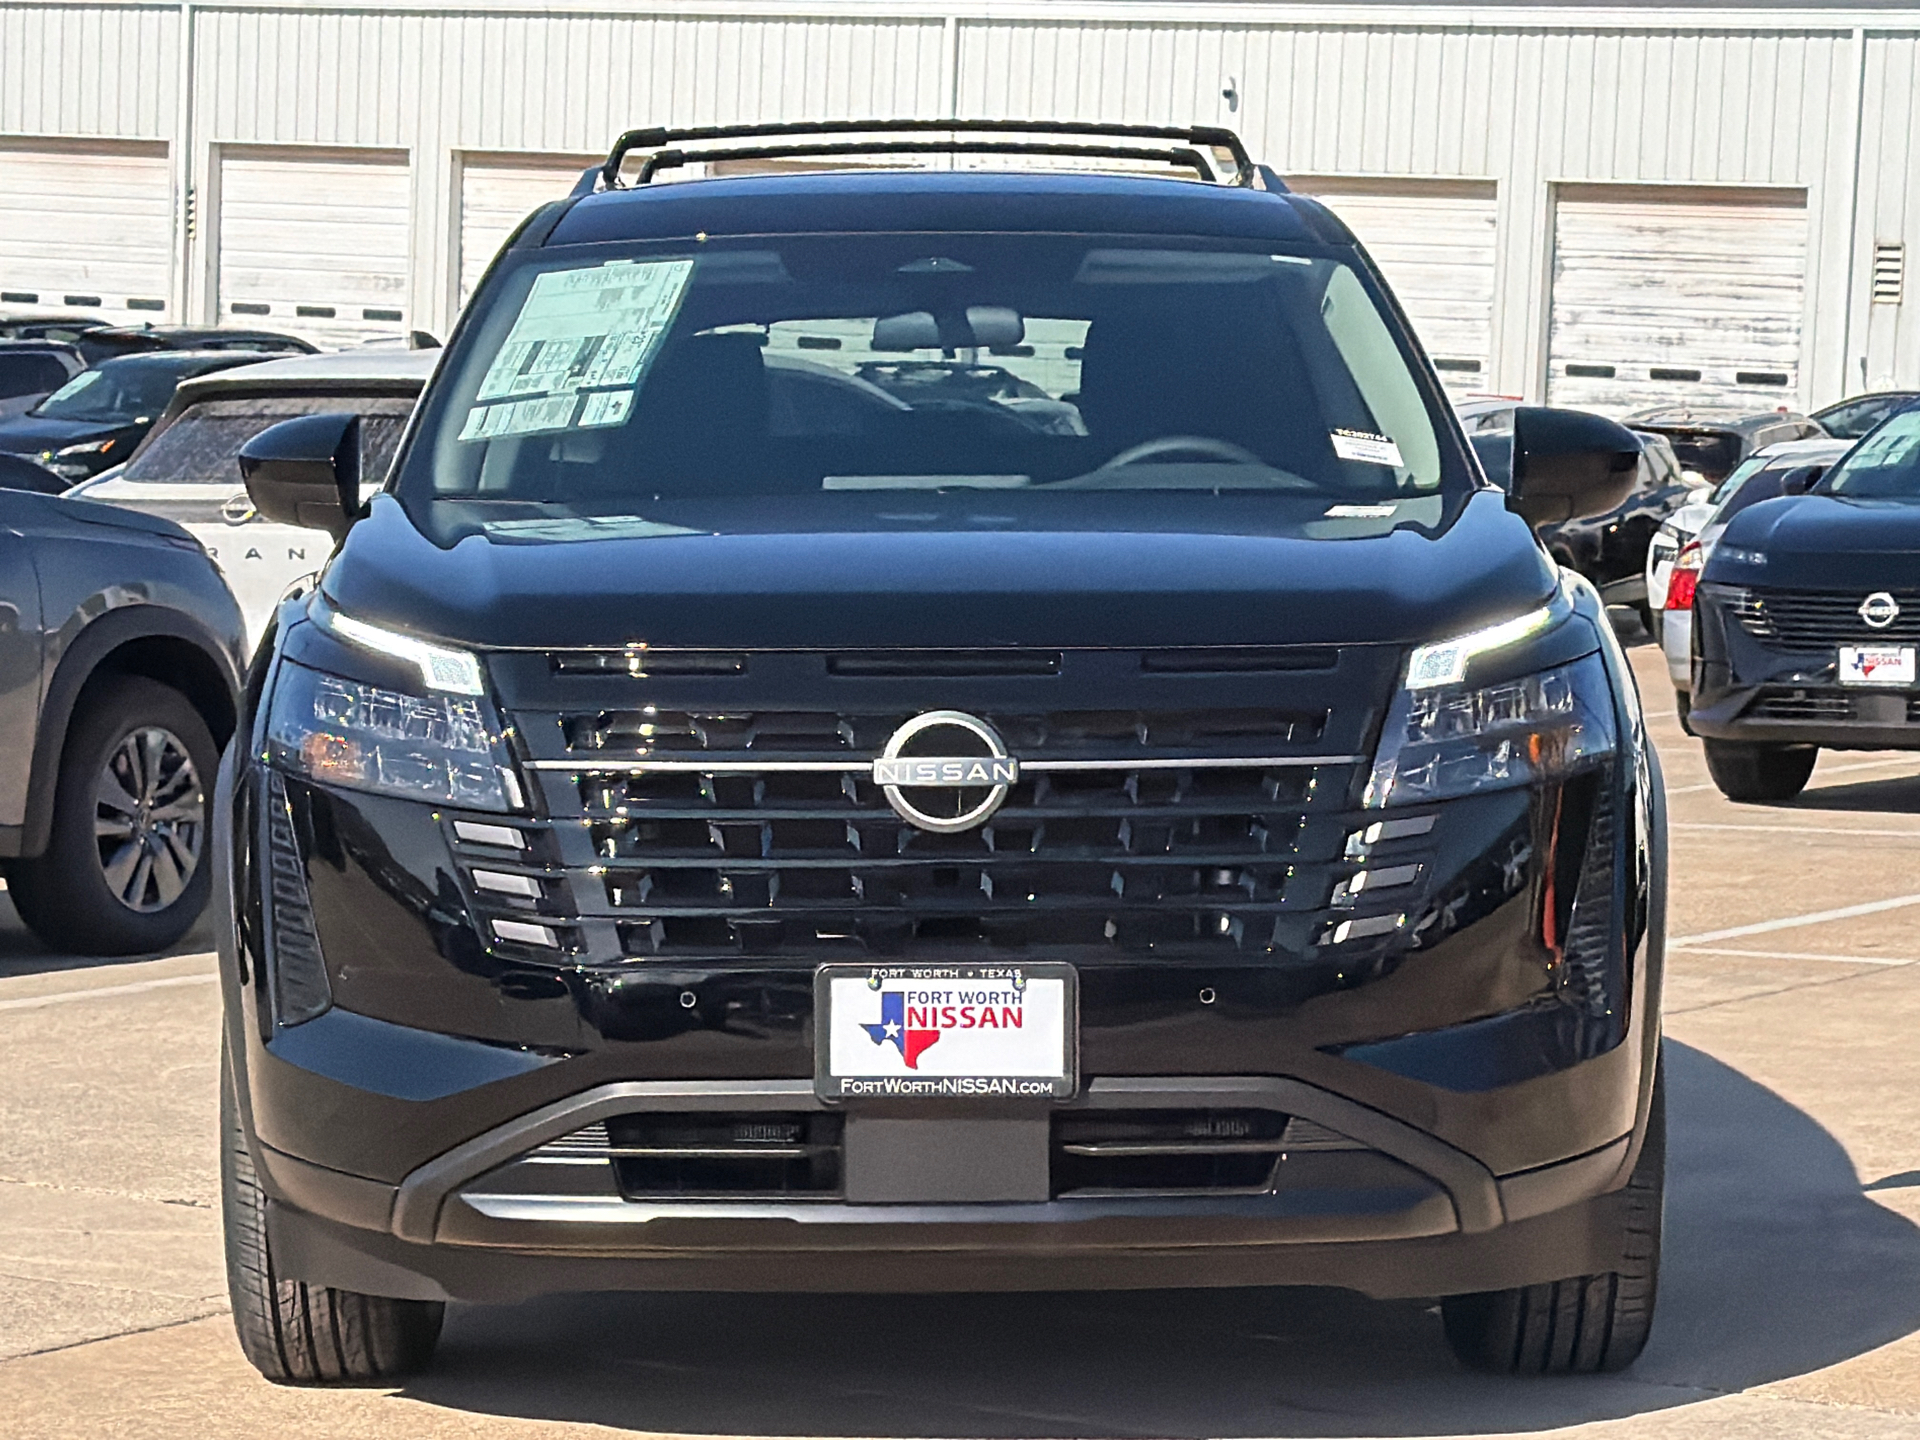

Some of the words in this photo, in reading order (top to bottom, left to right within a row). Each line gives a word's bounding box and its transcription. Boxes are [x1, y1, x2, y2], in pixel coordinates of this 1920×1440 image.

[878, 762, 1014, 781] NISSAN
[871, 968, 906, 979] FORT
[911, 968, 959, 979] WORTH
[979, 968, 1022, 979] TEXAS
[907, 991, 953, 1005] FORT
[958, 991, 1022, 1005] WORTH
[907, 1006, 1023, 1029] NISSAN
